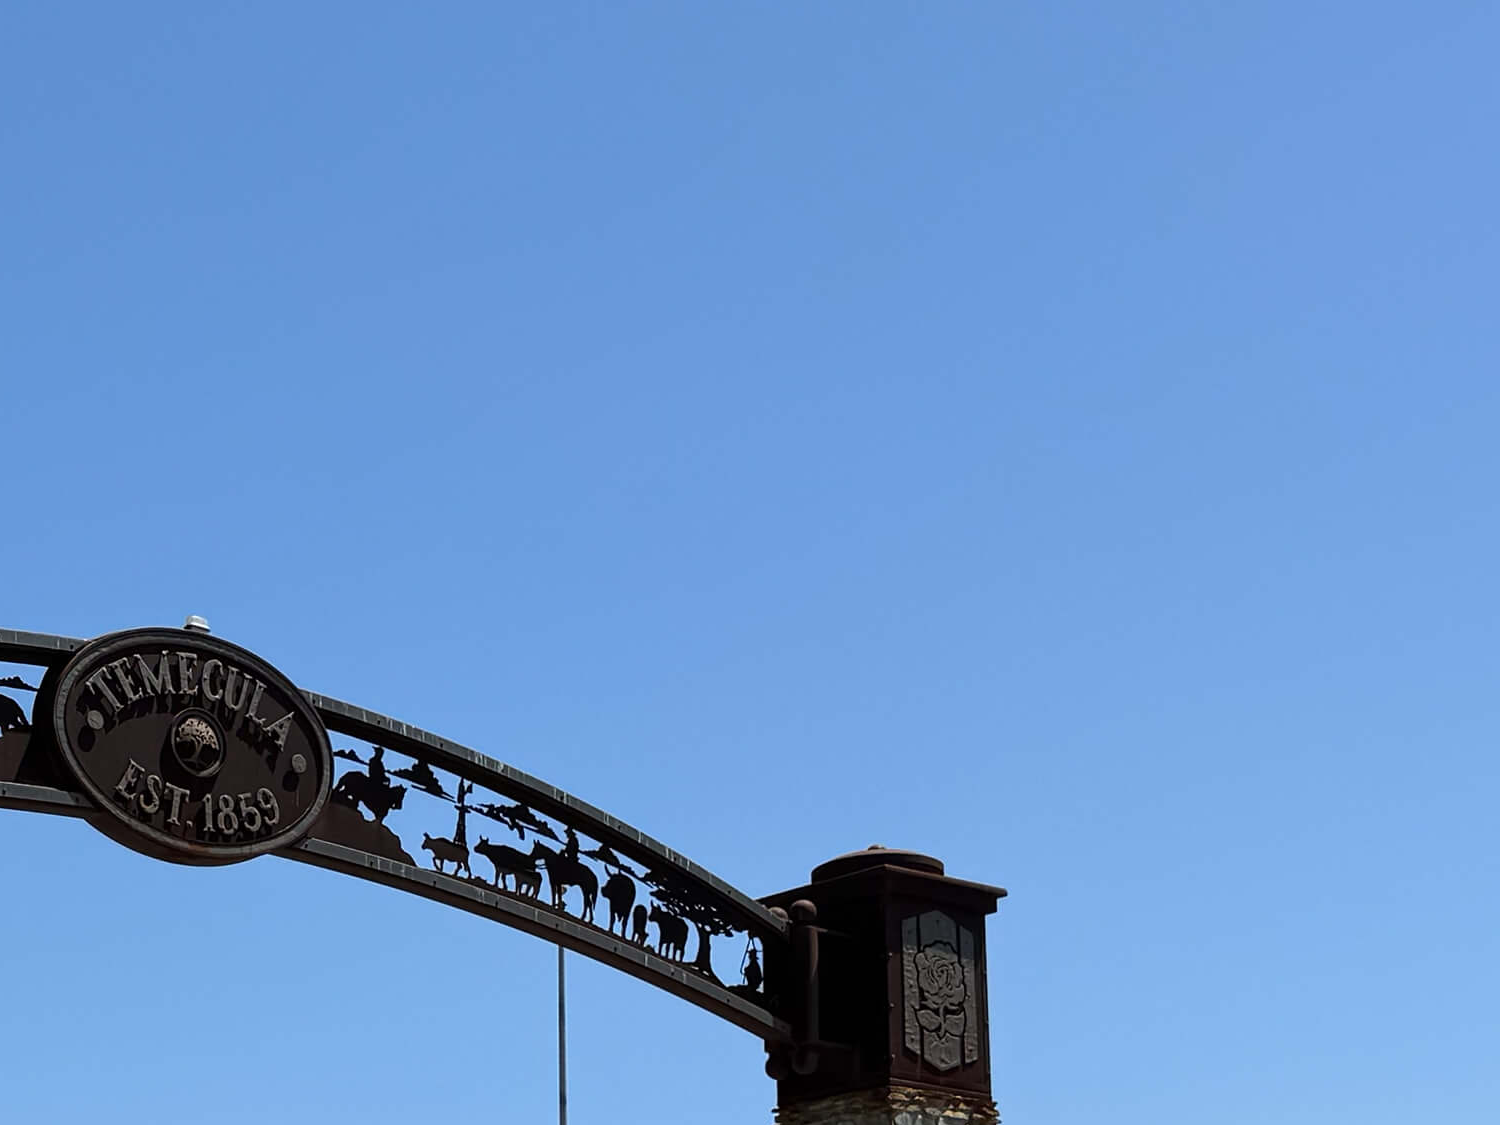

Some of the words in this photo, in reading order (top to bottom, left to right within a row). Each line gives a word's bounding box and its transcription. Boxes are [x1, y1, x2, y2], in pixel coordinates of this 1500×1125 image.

[85, 649, 295, 752] TEMECULA
[114, 757, 193, 827] EST.
[201, 787, 280, 835] 1859
